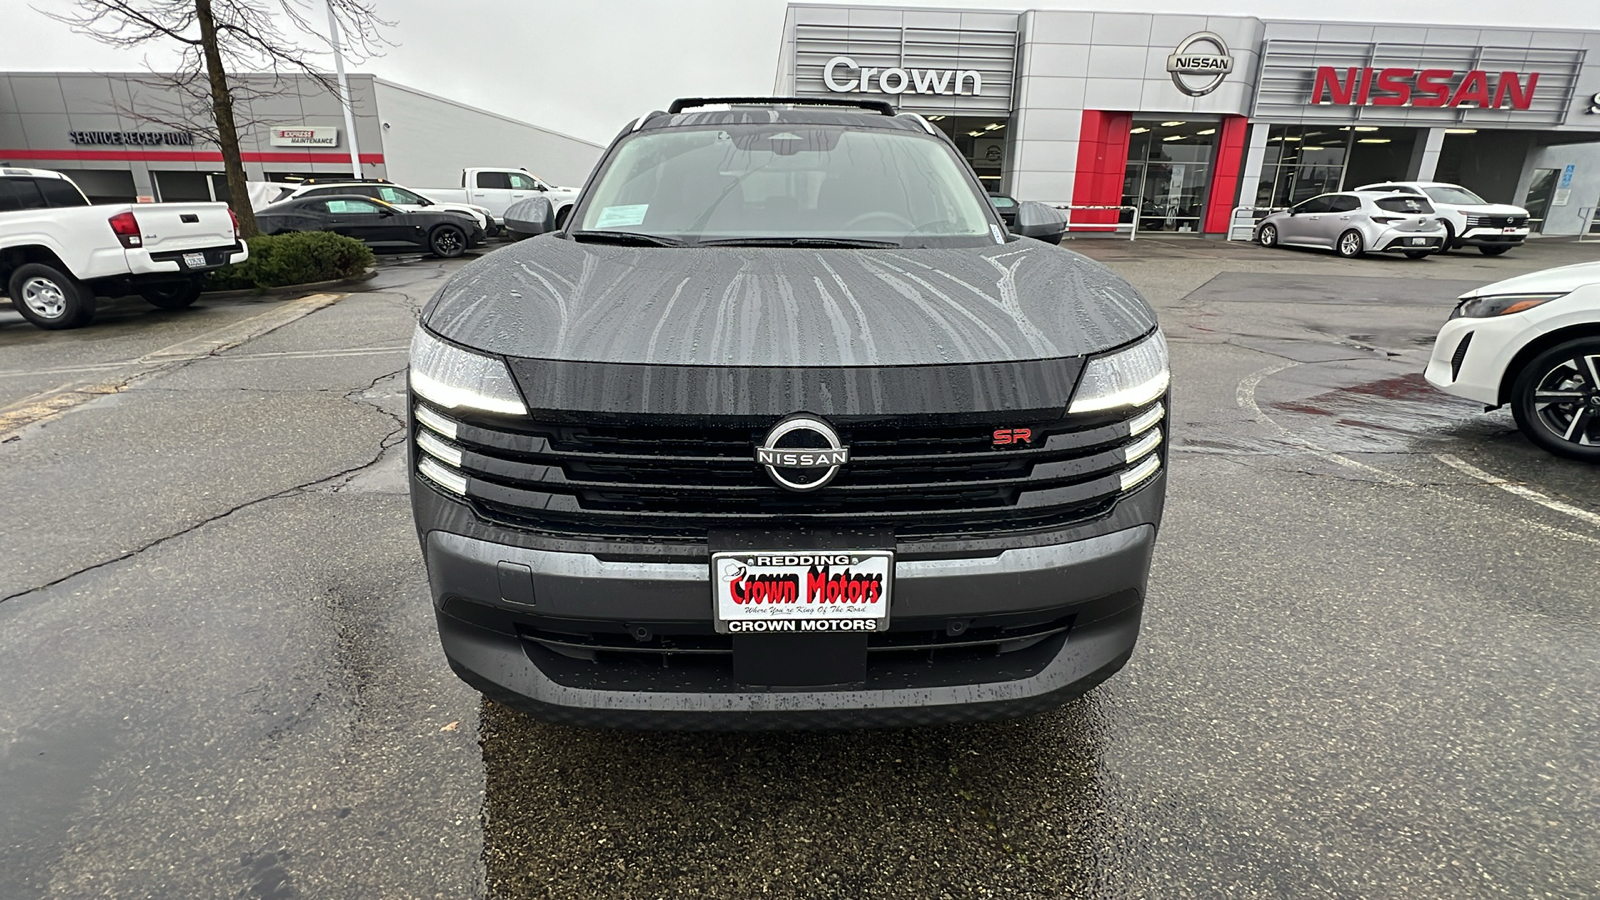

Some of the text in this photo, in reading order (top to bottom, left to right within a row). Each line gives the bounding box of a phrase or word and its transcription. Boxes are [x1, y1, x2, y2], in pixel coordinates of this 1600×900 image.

[1175, 57, 1229, 69] NISSAN
[823, 56, 982, 96] Crown
[1311, 66, 1540, 110] NISSAN
[69, 131, 194, 146] SERVICE RECEPTION
[993, 428, 1031, 445] SR
[758, 451, 847, 466] NISSAN
[757, 556, 849, 566] REDDING
[730, 568, 881, 604] Crown Motors
[744, 606, 767, 614] Where
[769, 606, 793, 616] You're
[796, 606, 814, 615] King
[817, 606, 827, 615] Of
[729, 620, 877, 632] CROWN MOTORS
